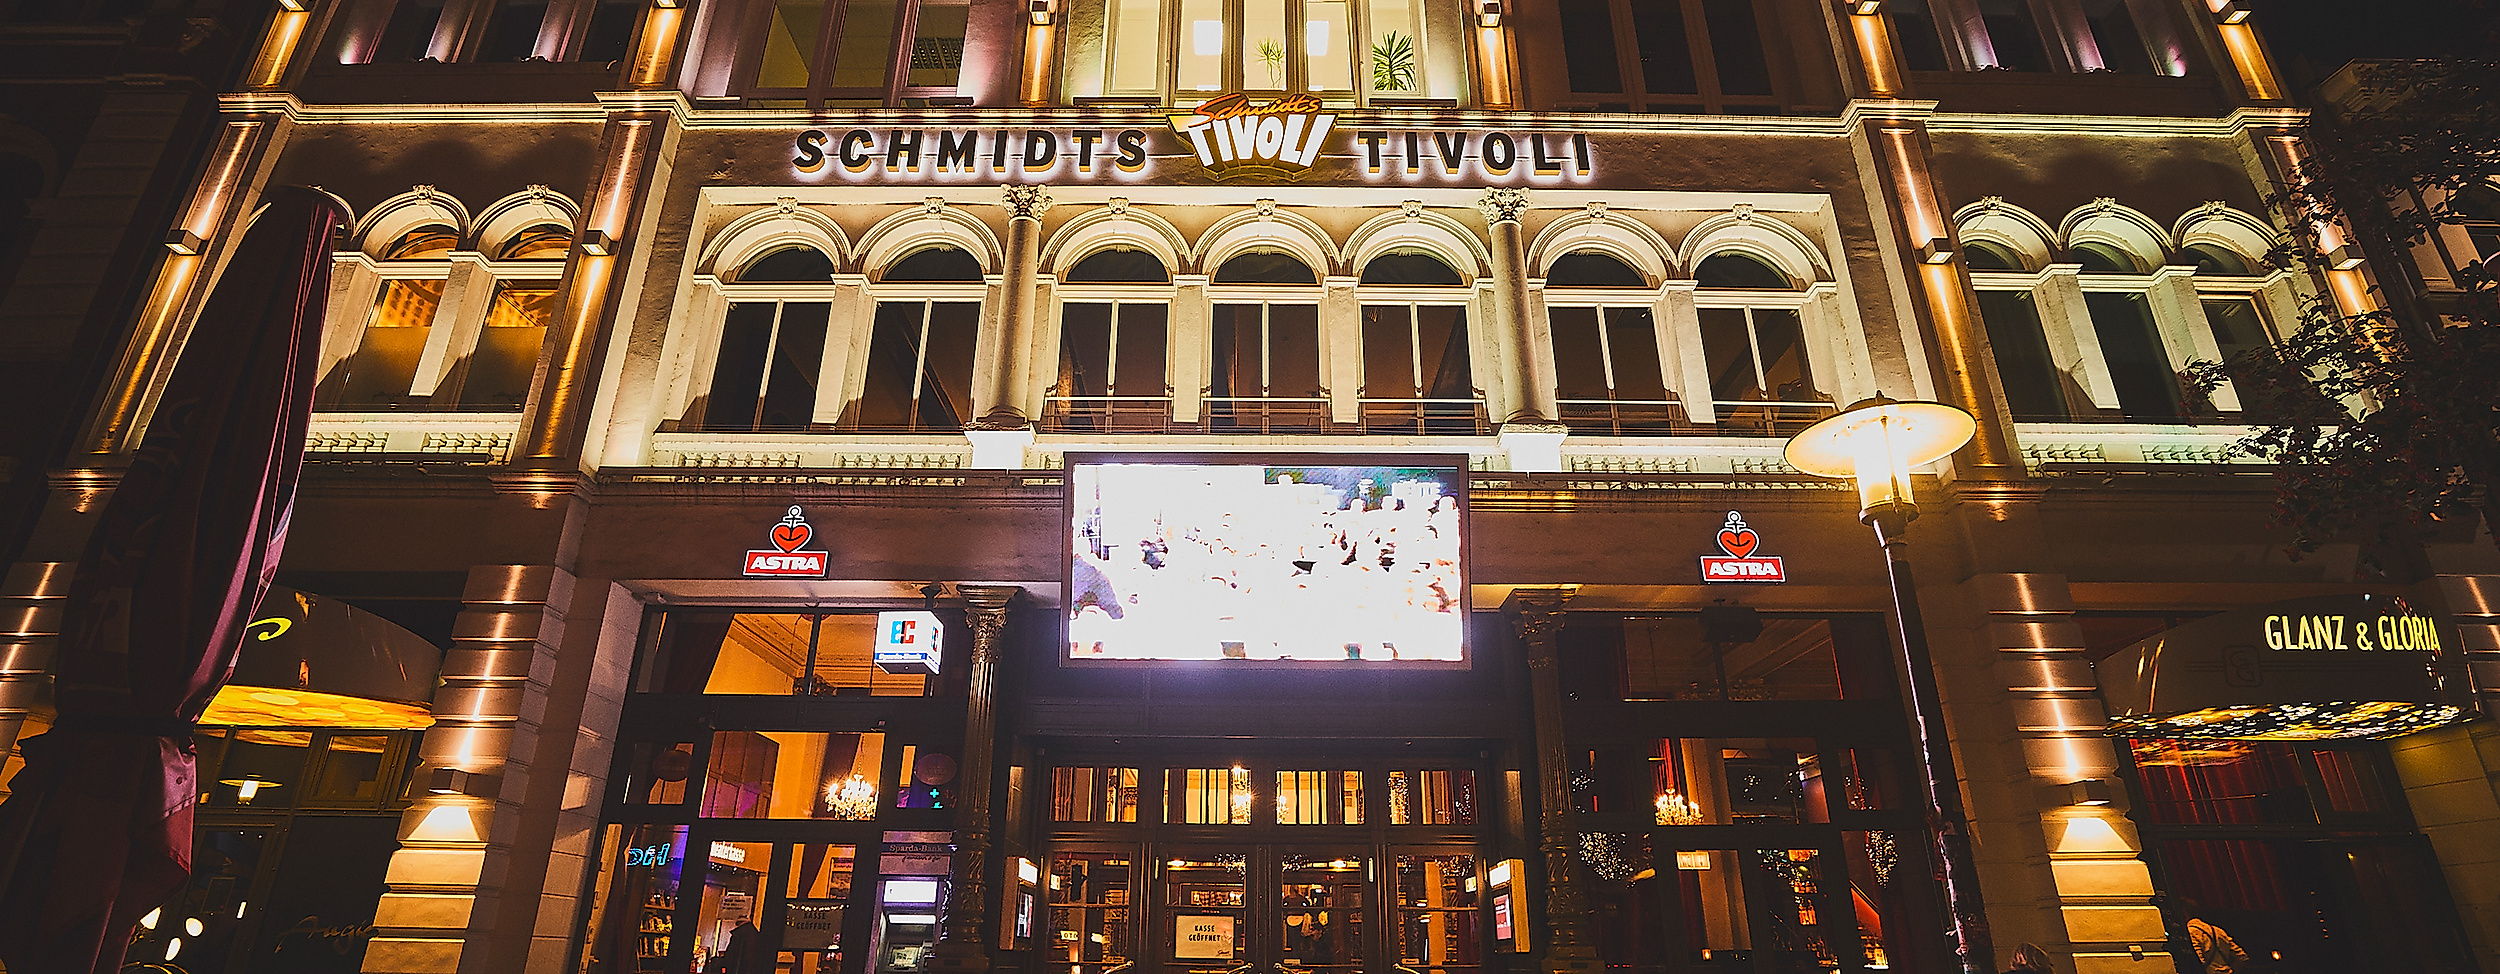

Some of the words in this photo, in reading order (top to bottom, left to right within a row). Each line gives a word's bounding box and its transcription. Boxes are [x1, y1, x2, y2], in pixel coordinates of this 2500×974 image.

[1188, 93, 1320, 128] Schmidts
[791, 130, 1147, 173] SCHMIDTS
[1168, 114, 1336, 167] TIVOLI
[1357, 131, 1591, 176] TIVOLI
[750, 556, 820, 571] ASTRA
[1709, 562, 1779, 576] ASTRA
[2264, 615, 2349, 651] GLANZ
[2355, 621, 2374, 652] &
[2377, 615, 2442, 653] GLORIA
[889, 844, 943, 853] Sparda-Bank
[1189, 933, 1221, 942] GEÖFFNET
